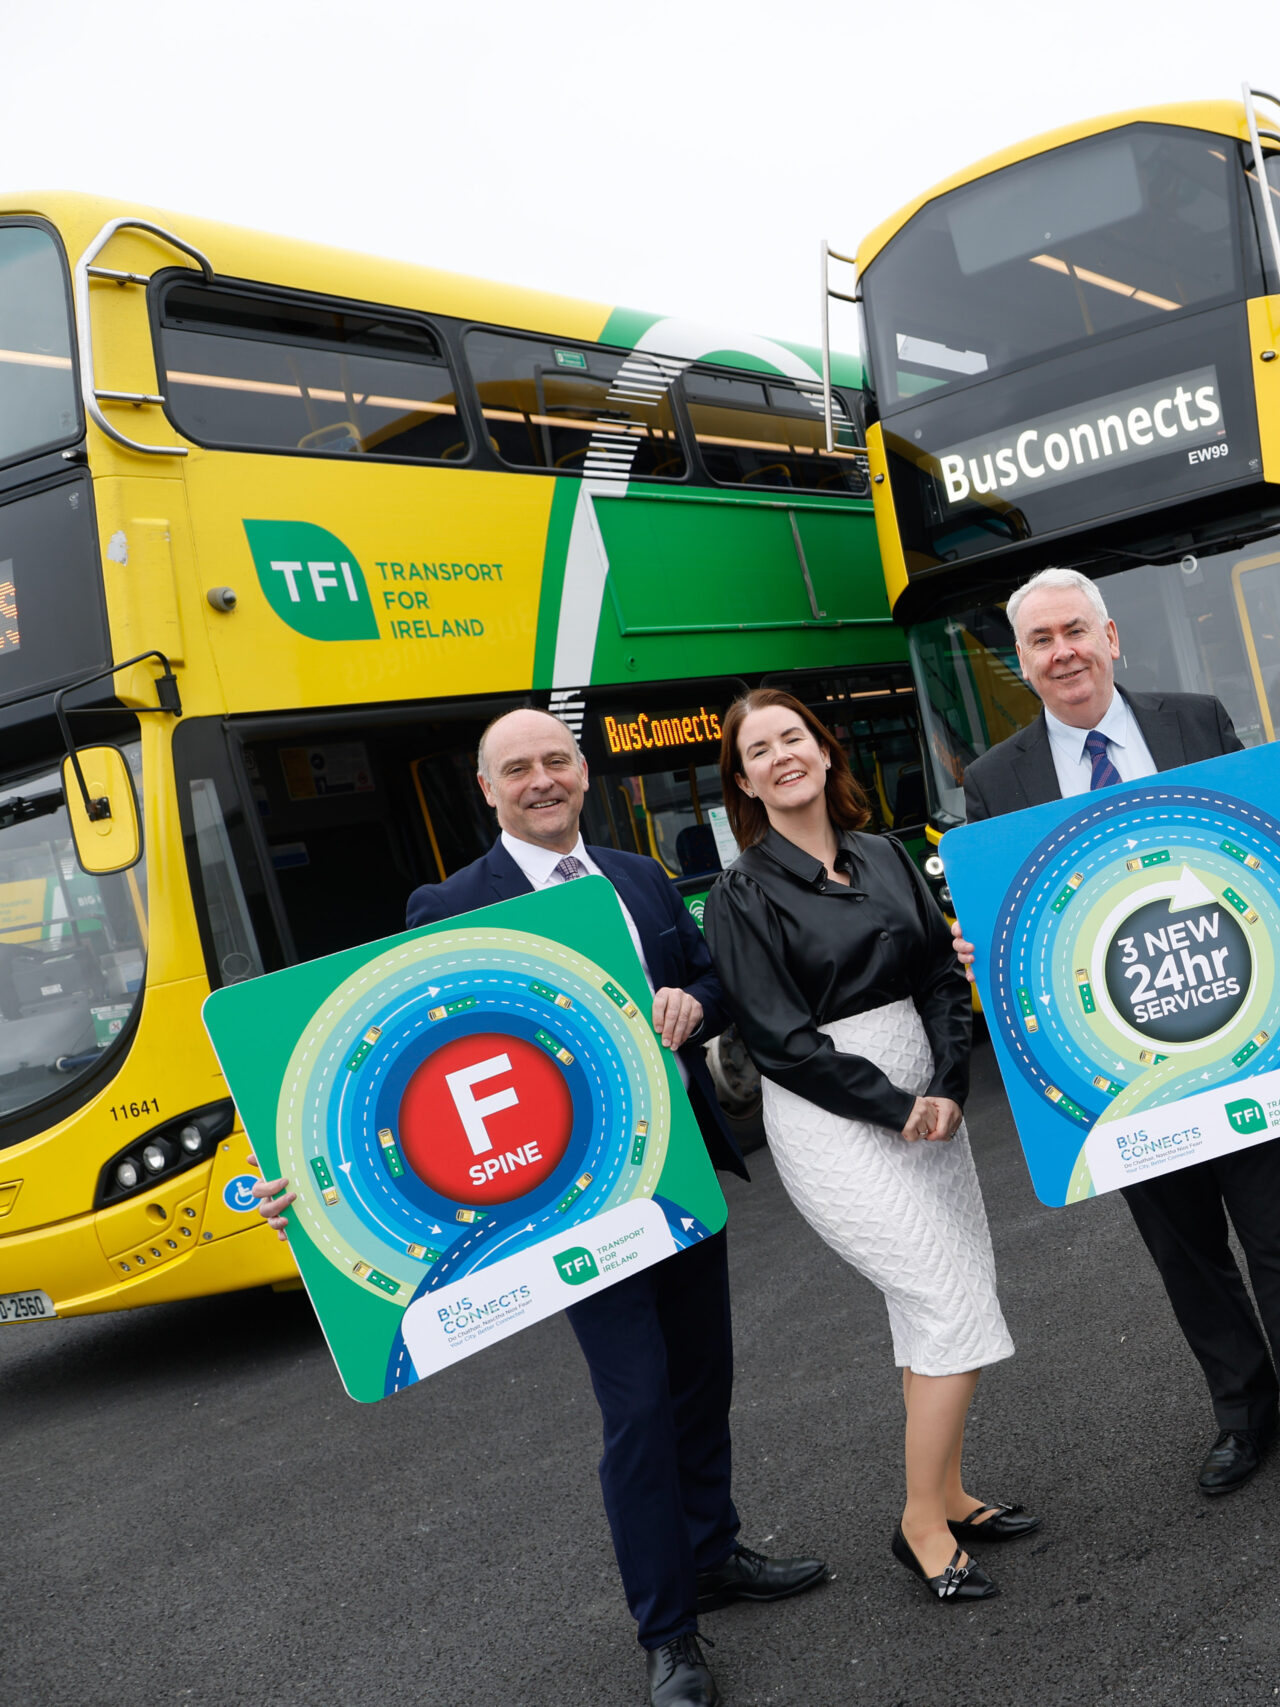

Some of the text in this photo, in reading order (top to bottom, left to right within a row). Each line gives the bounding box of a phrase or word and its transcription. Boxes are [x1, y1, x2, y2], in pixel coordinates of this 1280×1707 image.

[940, 385, 1220, 503] BusConnects
[1188, 443, 1229, 465] EW99
[270, 561, 359, 602] TFI
[375, 562, 503, 581] TRANSPORT
[383, 591, 430, 610] FOR
[391, 619, 485, 639] IRELAND
[604, 706, 723, 753] BusConnects
[1117, 912, 1219, 963] 3 NEW
[1124, 946, 1229, 1005] 24hr
[1133, 977, 1241, 1023] SERVICES
[110, 1098, 160, 1121] 11641
[445, 1053, 519, 1156] F
[1232, 1106, 1261, 1126] TFI
[1116, 1130, 1148, 1149] BUS
[1121, 1127, 1201, 1161] CONNECTS
[469, 1140, 543, 1186] SPINE
[596, 1227, 646, 1255] TRANSPORT
[561, 1254, 592, 1277] TFI
[600, 1251, 617, 1264] FOR
[603, 1251, 638, 1273] IRELAND
[0, 1296, 45, 1319] D-2560
[437, 1297, 473, 1322] BUS
[443, 1285, 530, 1334] CONNECTS
